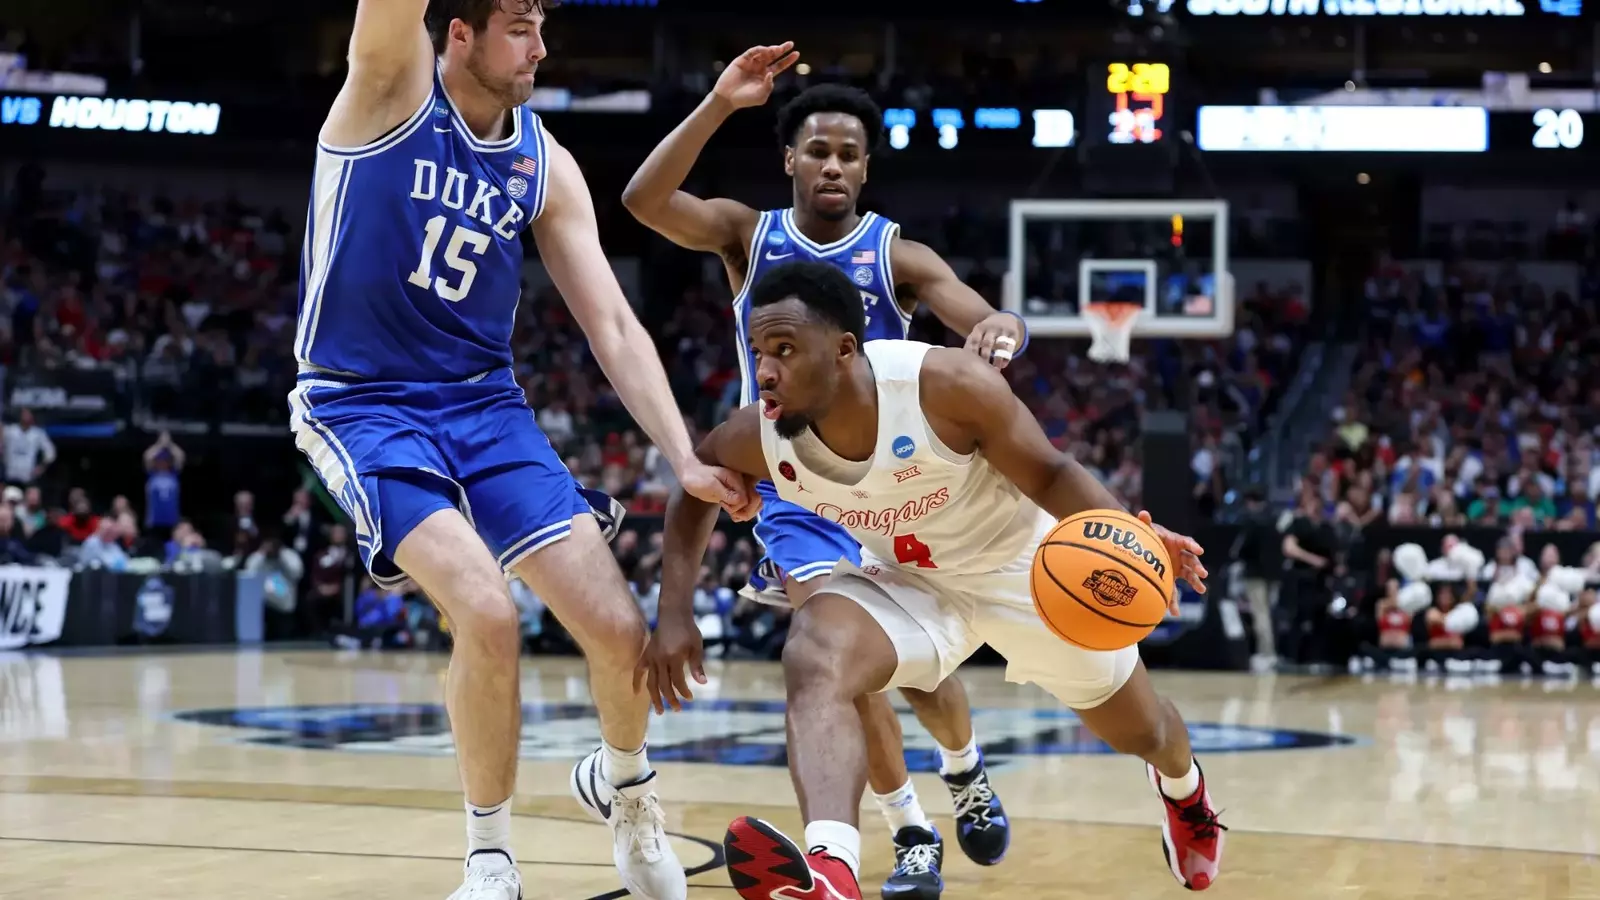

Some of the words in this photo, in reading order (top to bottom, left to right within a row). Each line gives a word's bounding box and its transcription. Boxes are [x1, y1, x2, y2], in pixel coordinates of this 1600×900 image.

[49, 96, 221, 134] HOUSTON
[1532, 108, 1584, 148] 20
[410, 159, 525, 240] DUKE
[408, 215, 491, 303] 15
[815, 487, 949, 536] Cougars
[894, 533, 938, 569] 4
[1083, 521, 1166, 580] Wilson
[1098, 583, 1132, 604] MADNESS
[1099, 574, 1126, 593] MARCH
